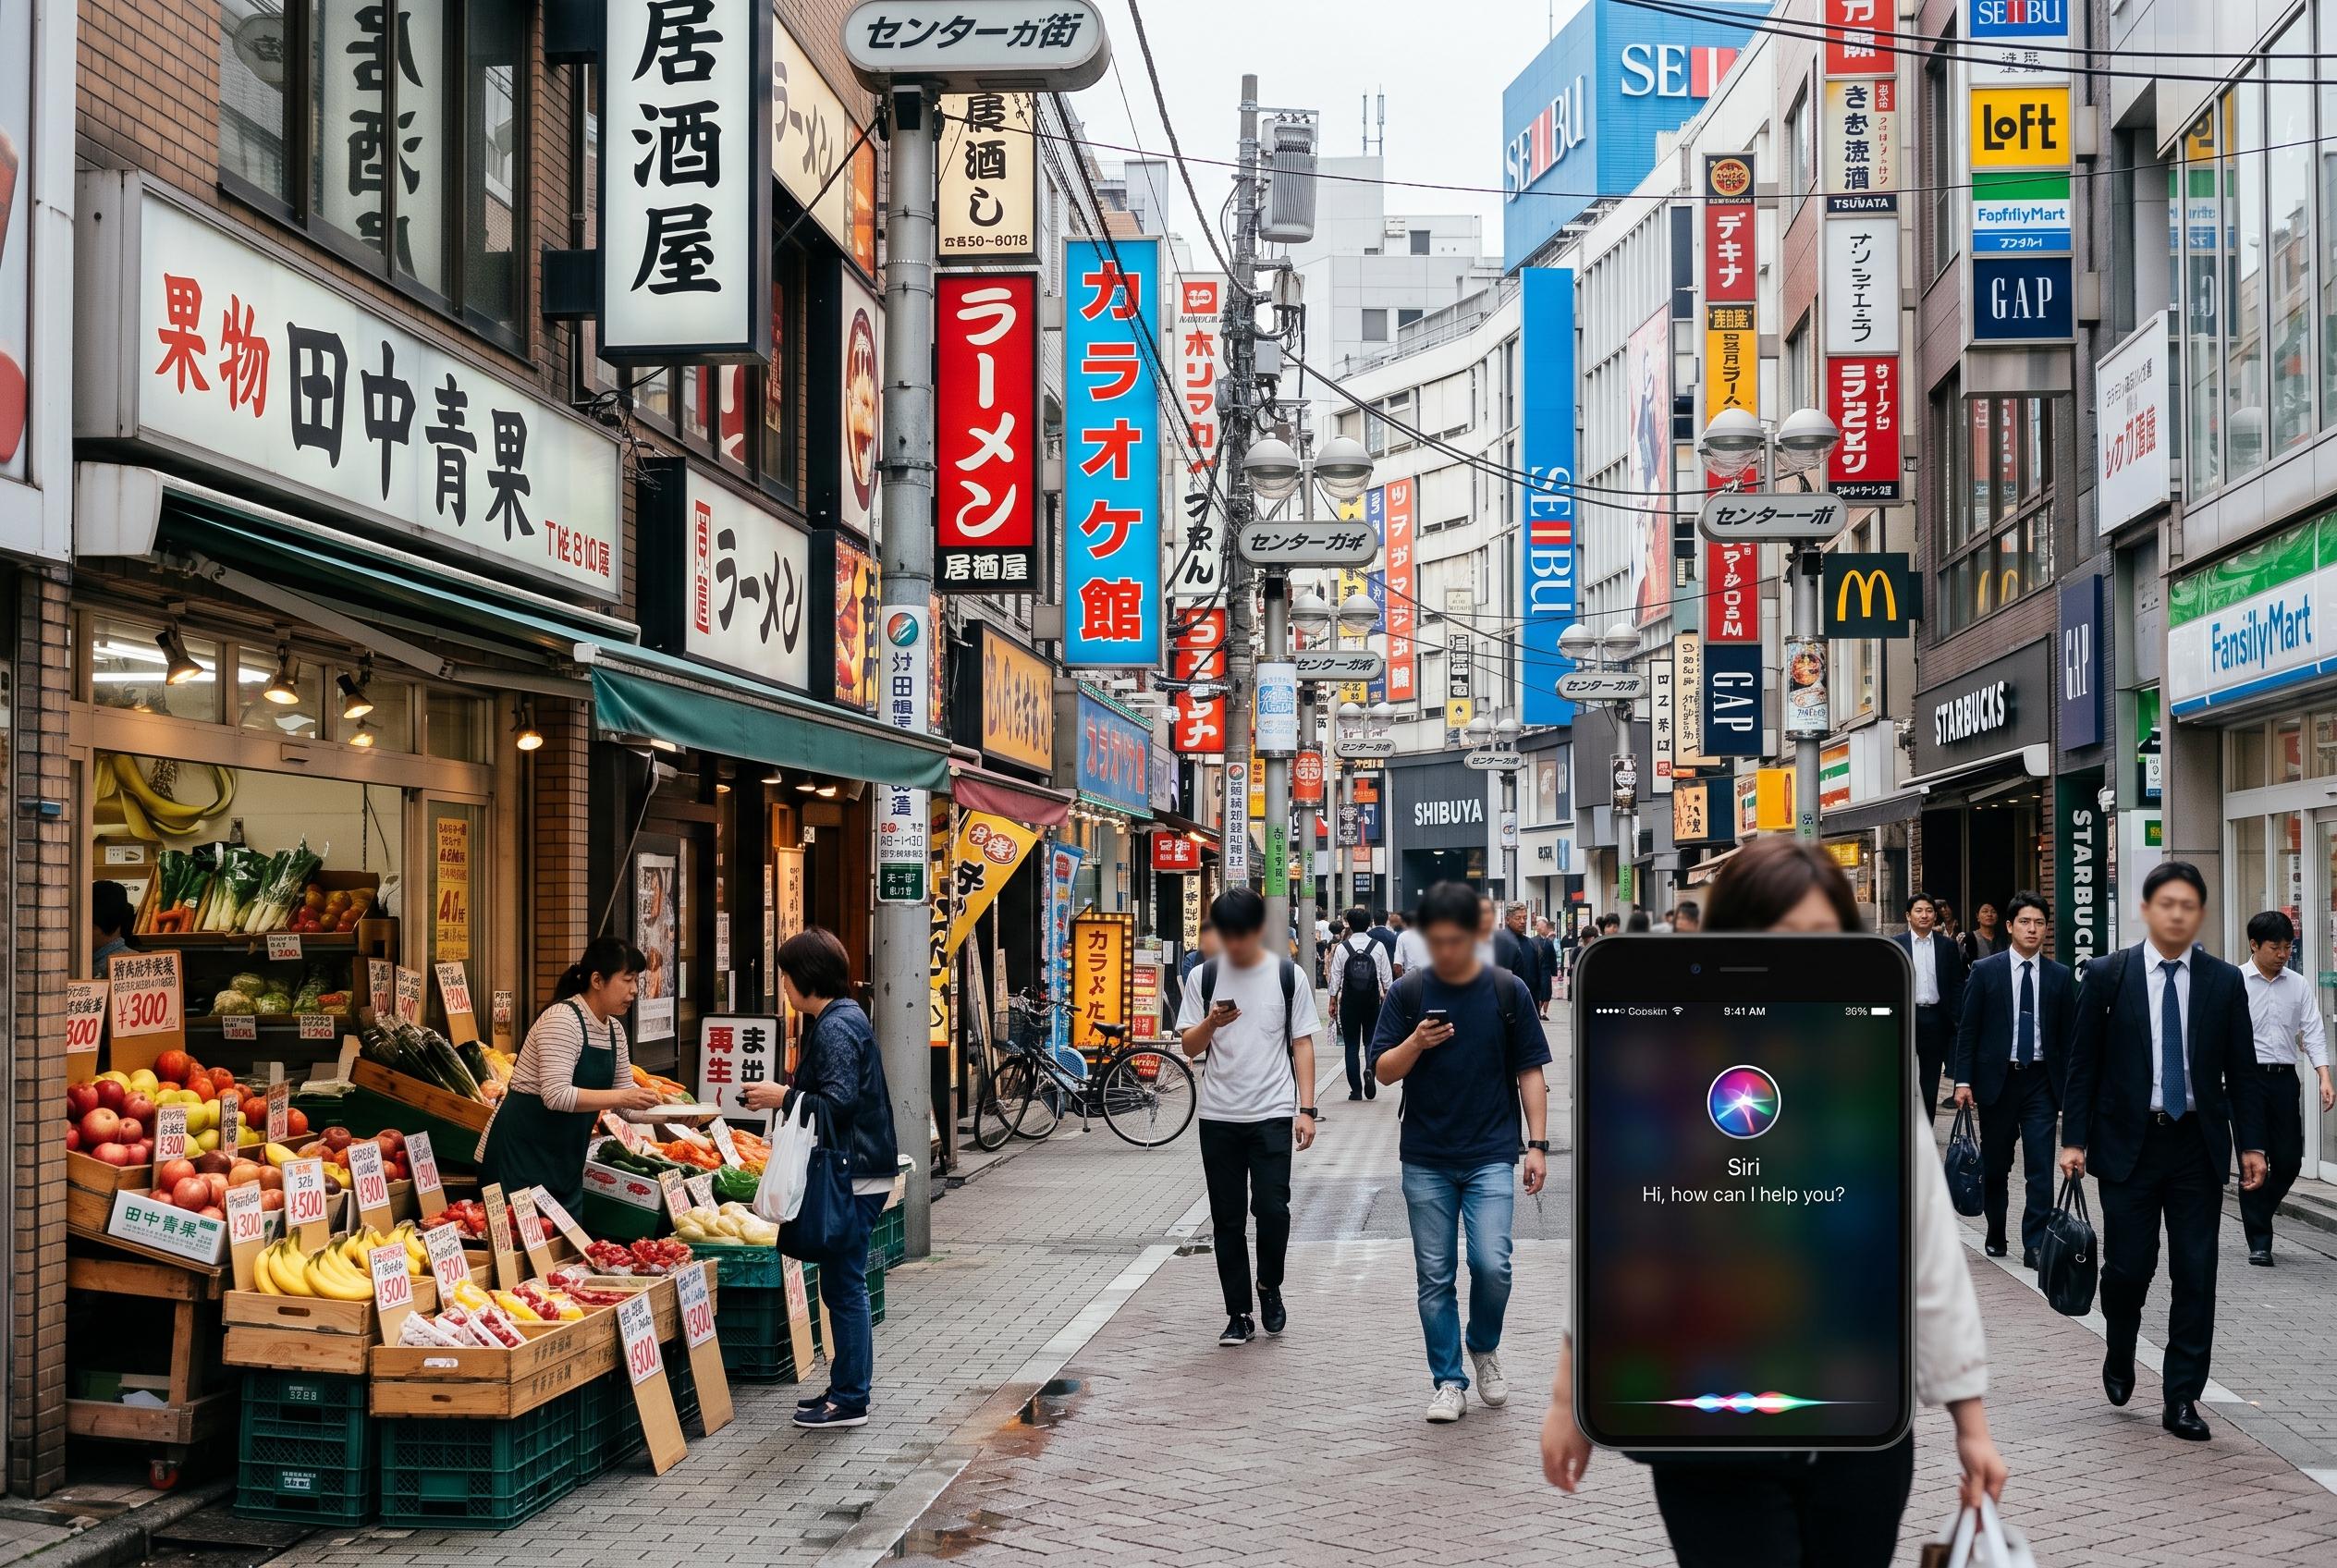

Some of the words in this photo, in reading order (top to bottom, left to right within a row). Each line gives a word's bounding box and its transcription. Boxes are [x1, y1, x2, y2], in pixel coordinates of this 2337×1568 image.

[630, 0, 724, 296] 居酒屋
[1991, 276, 2053, 320] GAP
[155, 273, 271, 419] 果物
[287, 320, 535, 543] 田中青果
[955, 286, 1018, 539] ラーメン
[1079, 259, 1143, 643] カラオケ館
[945, 553, 1028, 582] 居酒屋
[2065, 622, 2089, 701] GAP
[1712, 671, 1754, 732] GAP
[1934, 680, 2005, 747] STARBUCKS
[1414, 798, 1484, 827] SHIBUYA
[117, 991, 168, 1030] ¥300
[1723, 1007, 1745, 1016] 9:41
[1748, 1007, 1766, 1016] AM
[1727, 1158, 1760, 1177] Siri
[1643, 1187, 1665, 1205] Hi,
[1671, 1187, 1707, 1202] how
[1713, 1191, 1745, 1202] can
[1751, 1187, 1755, 1202] I
[1760, 1187, 1798, 1206] help
[1804, 1187, 1845, 1206] you?
[126, 1207, 197, 1239] 田中青果
